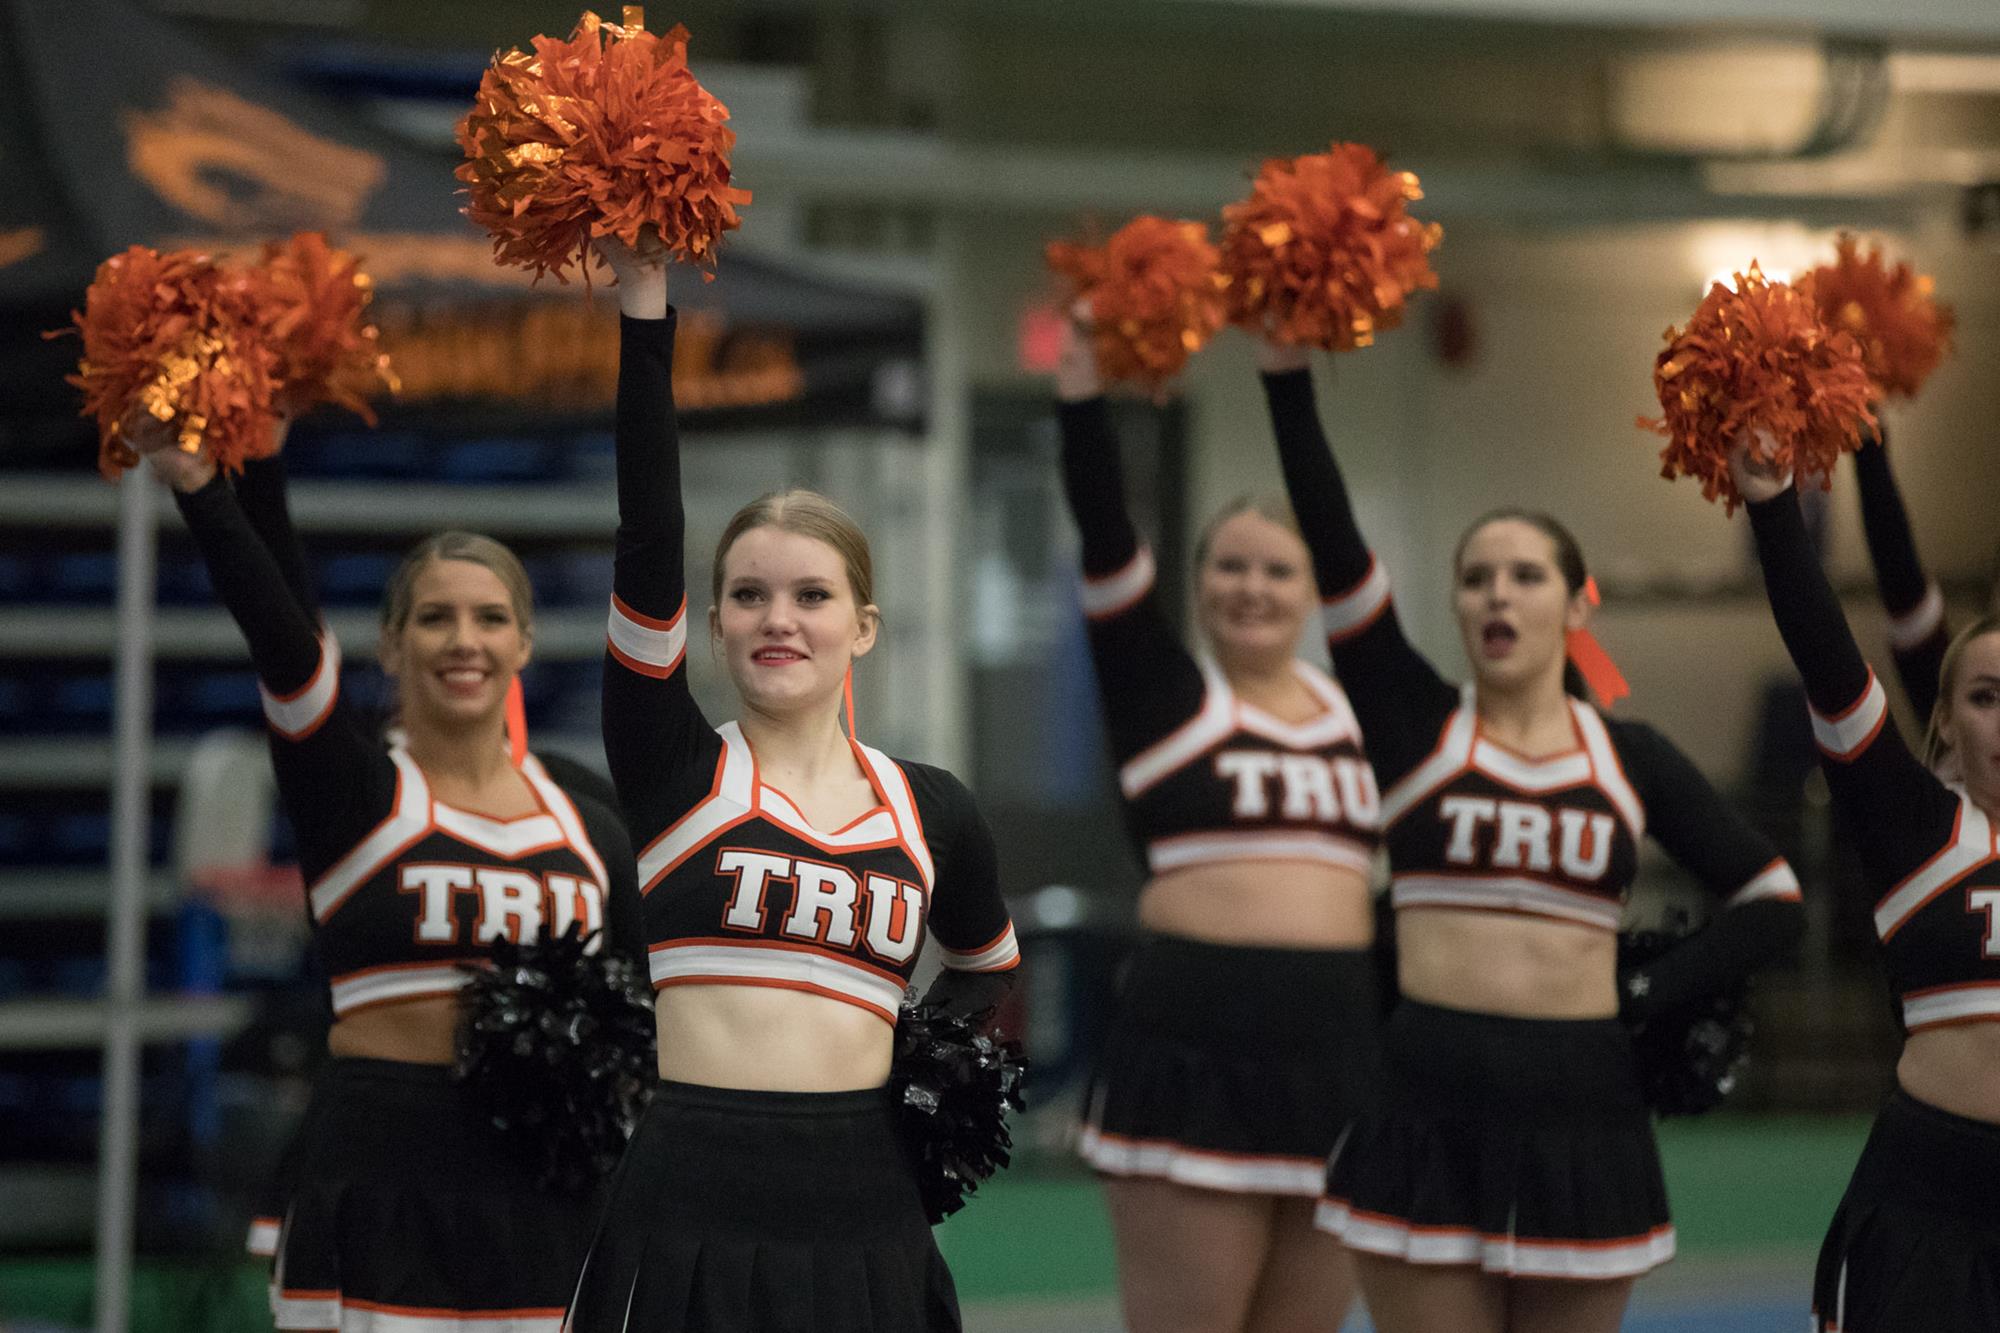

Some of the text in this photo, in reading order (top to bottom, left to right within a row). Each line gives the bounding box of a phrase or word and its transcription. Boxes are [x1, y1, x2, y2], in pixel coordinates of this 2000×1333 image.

[1216, 750, 1380, 827] TRU
[1439, 797, 1615, 880] TRU
[400, 862, 605, 955] TRU
[717, 848, 928, 966] TRU
